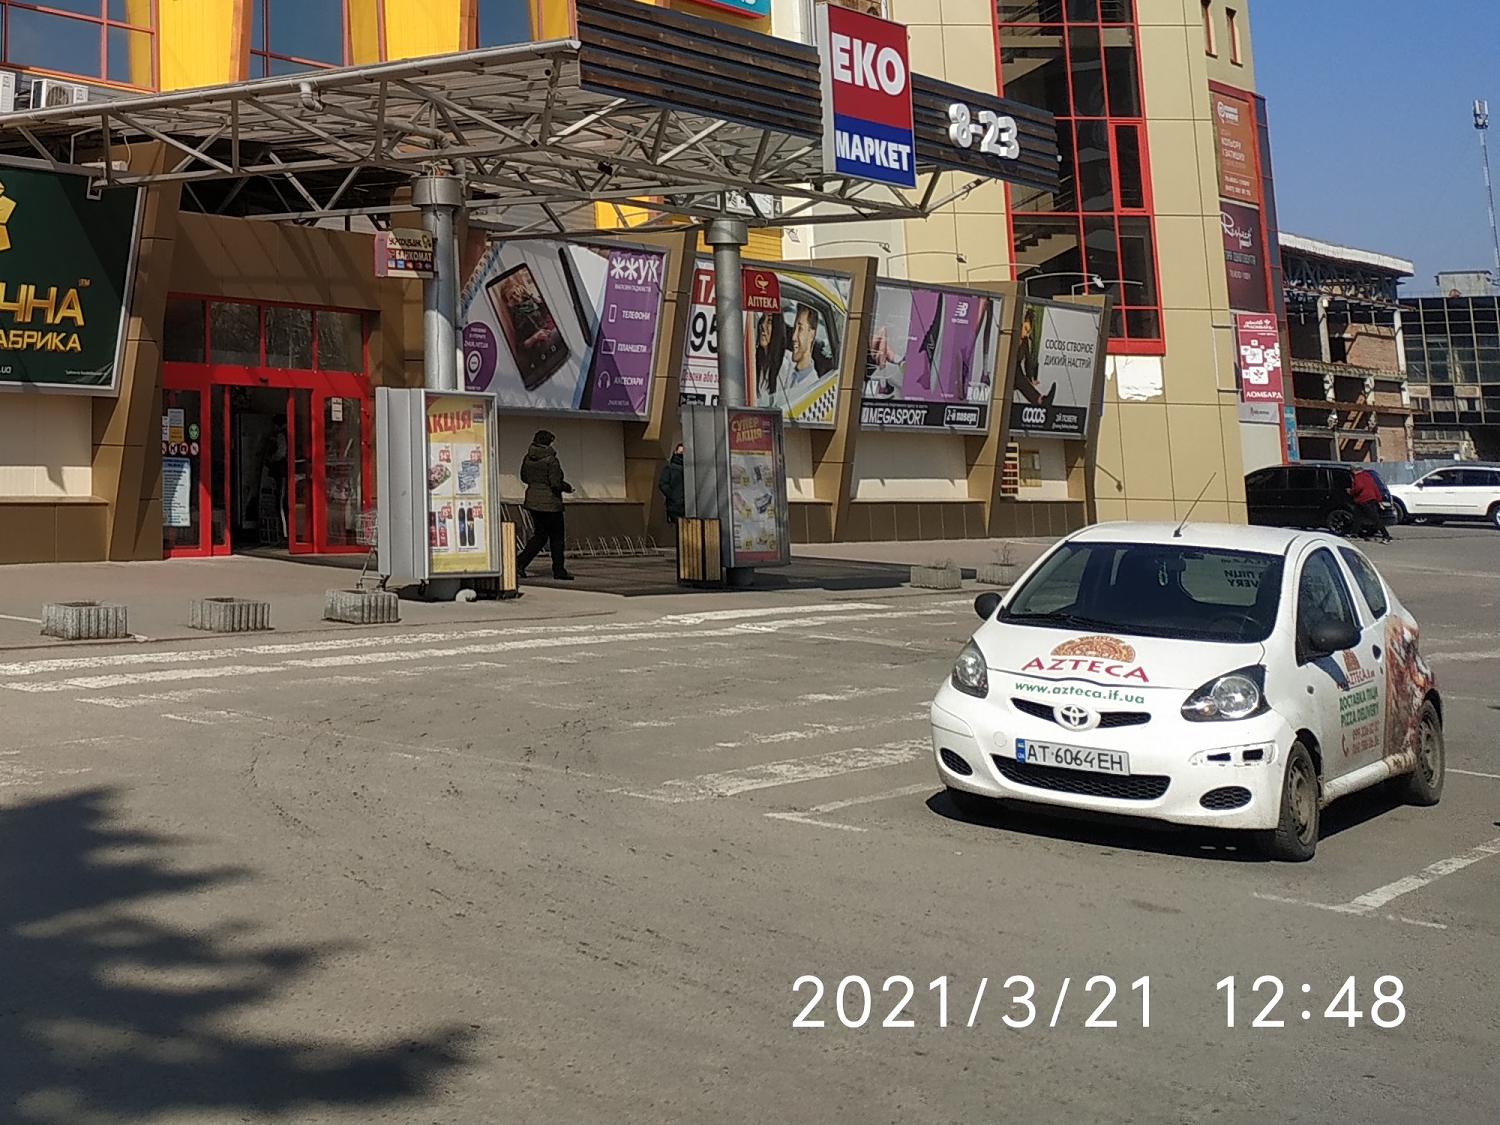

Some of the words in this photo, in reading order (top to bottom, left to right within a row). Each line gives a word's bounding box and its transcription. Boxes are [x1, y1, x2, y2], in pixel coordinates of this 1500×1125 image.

[831, 31, 906, 96] ЕКО
[948, 103, 1020, 160] 8-23
[835, 129, 911, 171] МАРКЕТ
[748, 295, 779, 310] АПТЕКА
[622, 310, 650, 320] ТЕЛЕФОНИ
[1246, 390, 1283, 399] ЛОМБАРД
[731, 416, 759, 432] СУПЕР
[869, 408, 927, 425] MEGASPORT
[1022, 407, 1047, 424] COCOS
[1021, 657, 1149, 683] AZTECA
[1015, 682, 1145, 704] www.azteca.if.ua
